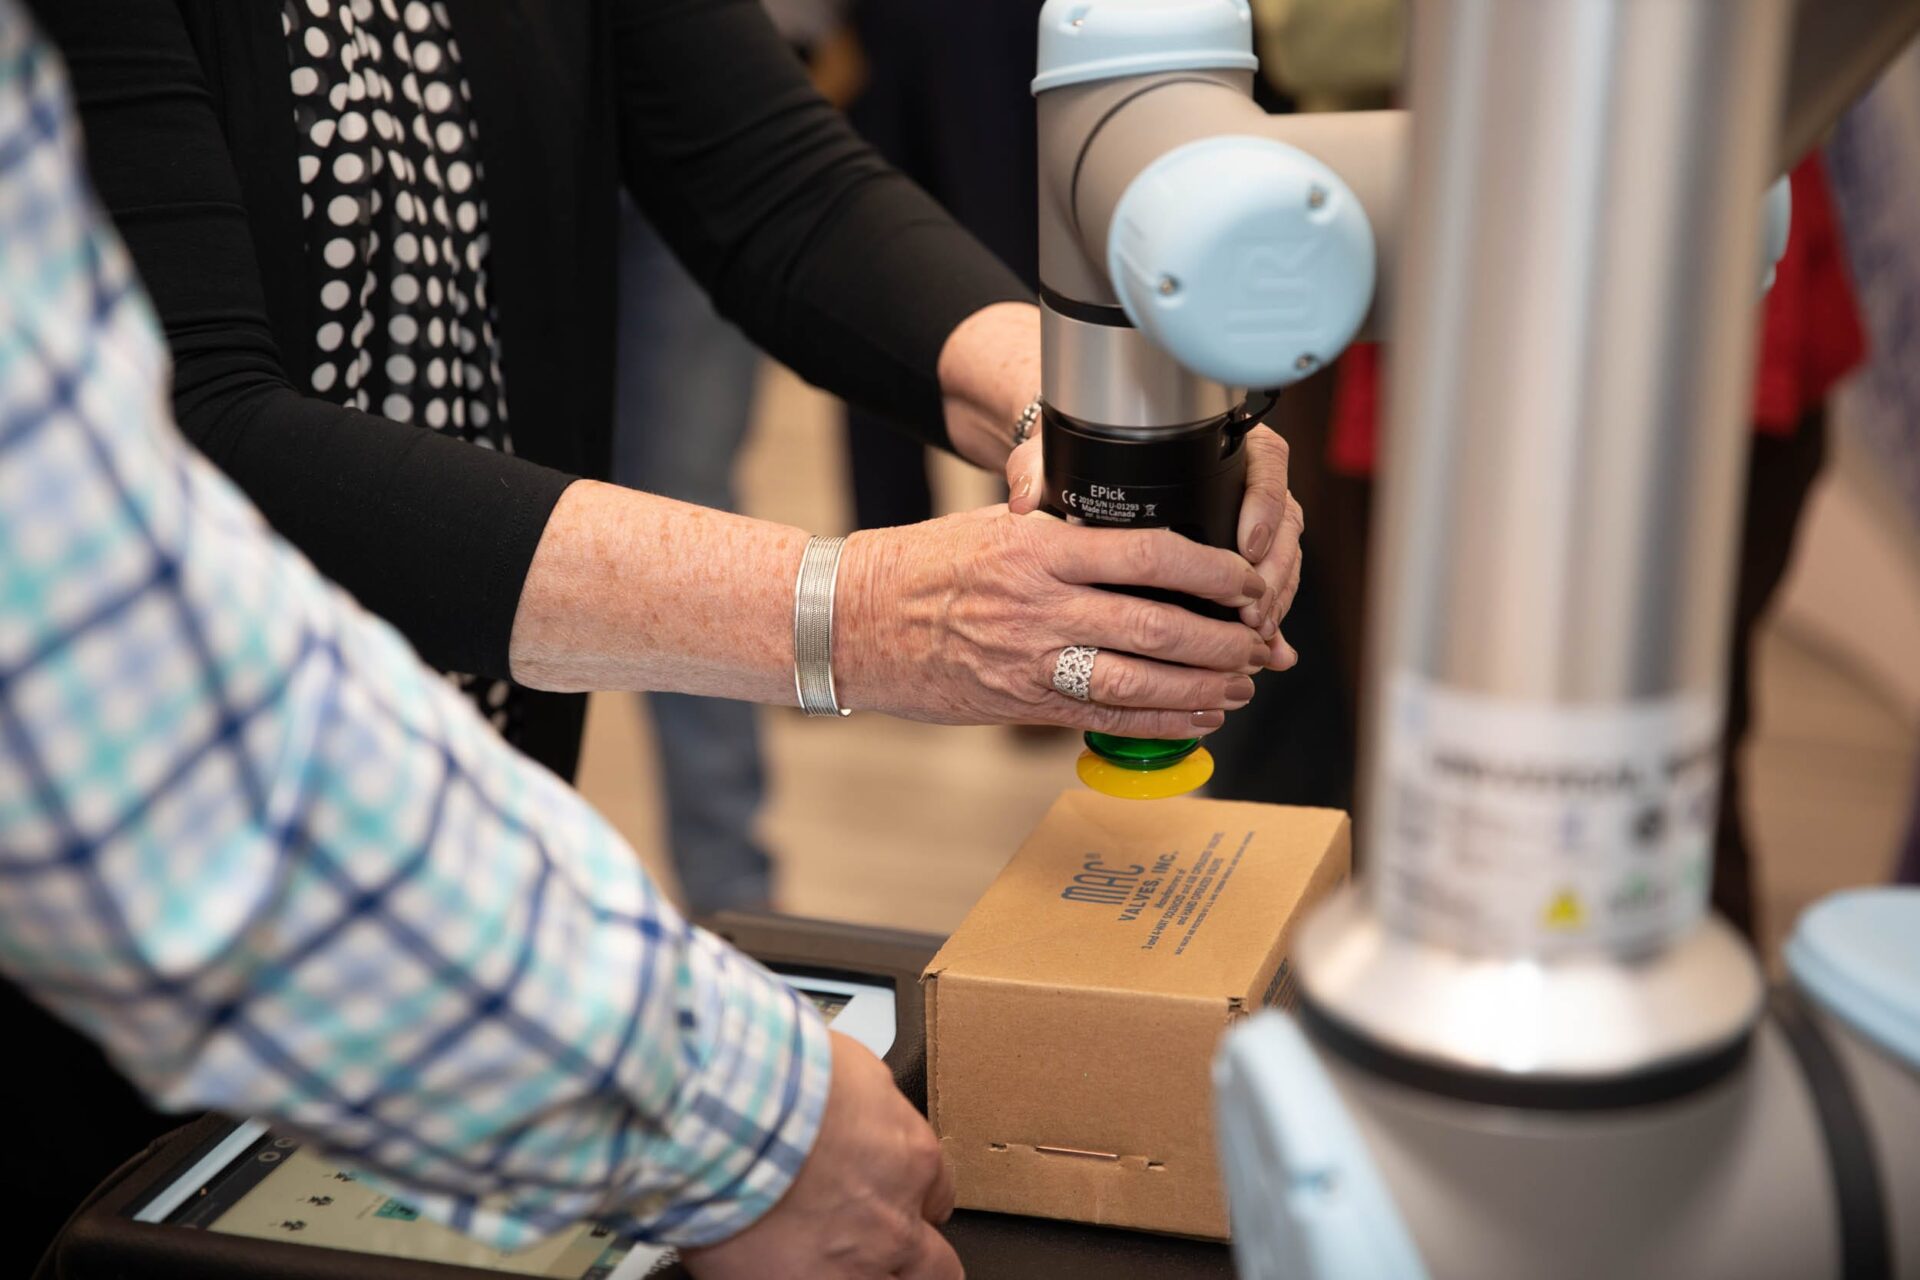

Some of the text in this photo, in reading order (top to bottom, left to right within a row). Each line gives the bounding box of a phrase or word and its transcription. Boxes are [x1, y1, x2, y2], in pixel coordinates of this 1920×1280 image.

[1090, 484, 1125, 501] EPick
[1079, 495, 1094, 505] 2019
[1095, 499, 1108, 508] S/N
[1081, 503, 1100, 514] Made
[1100, 507, 1108, 515] in
[1108, 508, 1136, 518] Canada
[1061, 859, 1145, 905] MAC
[1117, 851, 1179, 922] VALVES, INC.
